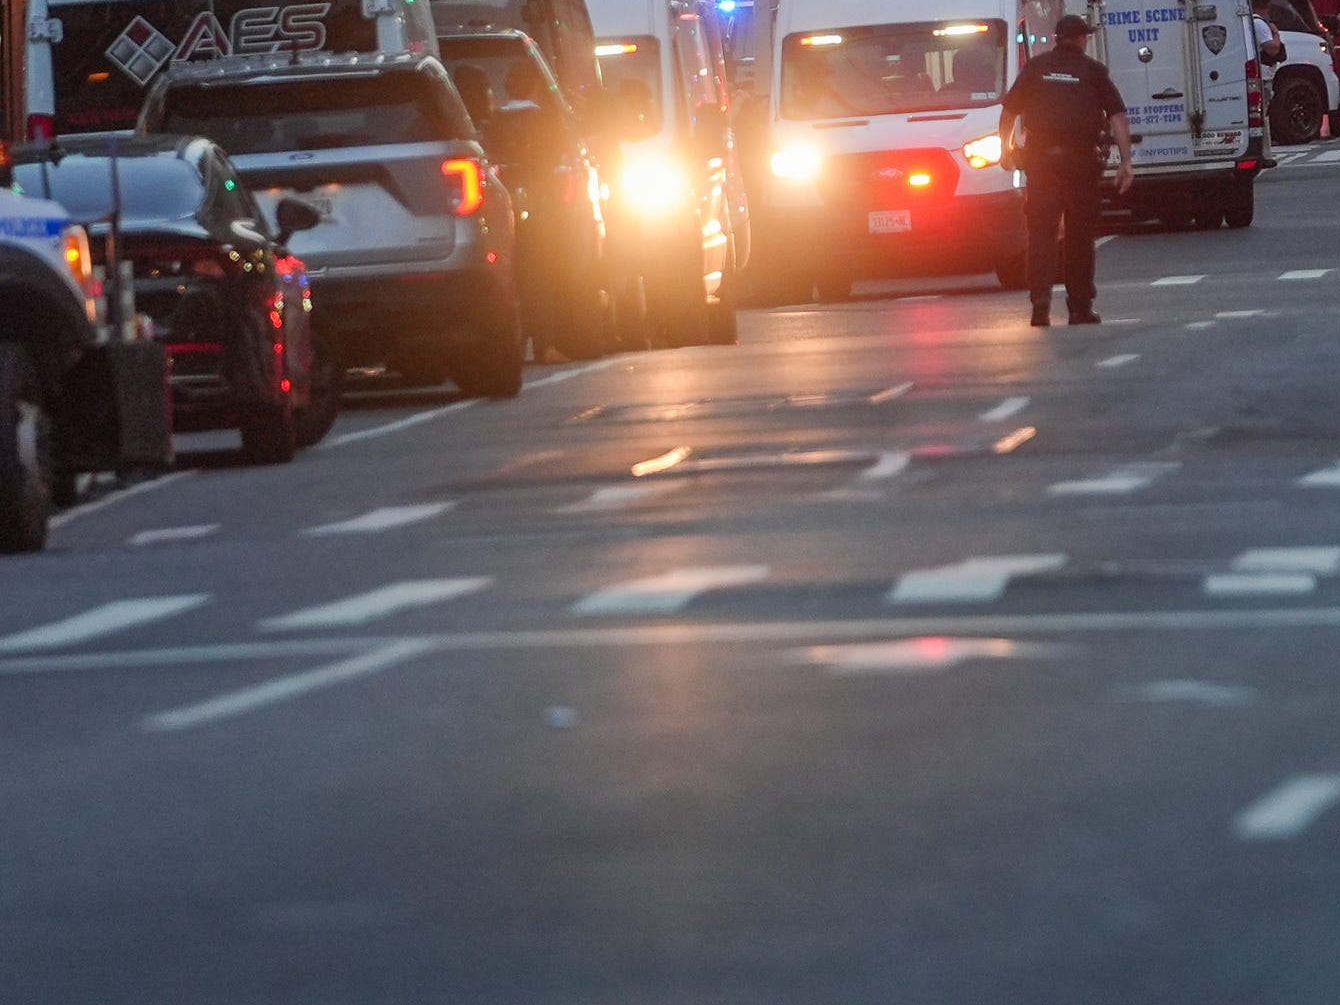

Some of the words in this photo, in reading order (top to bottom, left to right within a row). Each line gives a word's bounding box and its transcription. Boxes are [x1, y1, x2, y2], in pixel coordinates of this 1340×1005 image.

[1100, 10, 1141, 26] CRIME
[1146, 8, 1185, 23] SCENE
[171, 2, 332, 62] AES
[1128, 28, 1159, 43] UNIT
